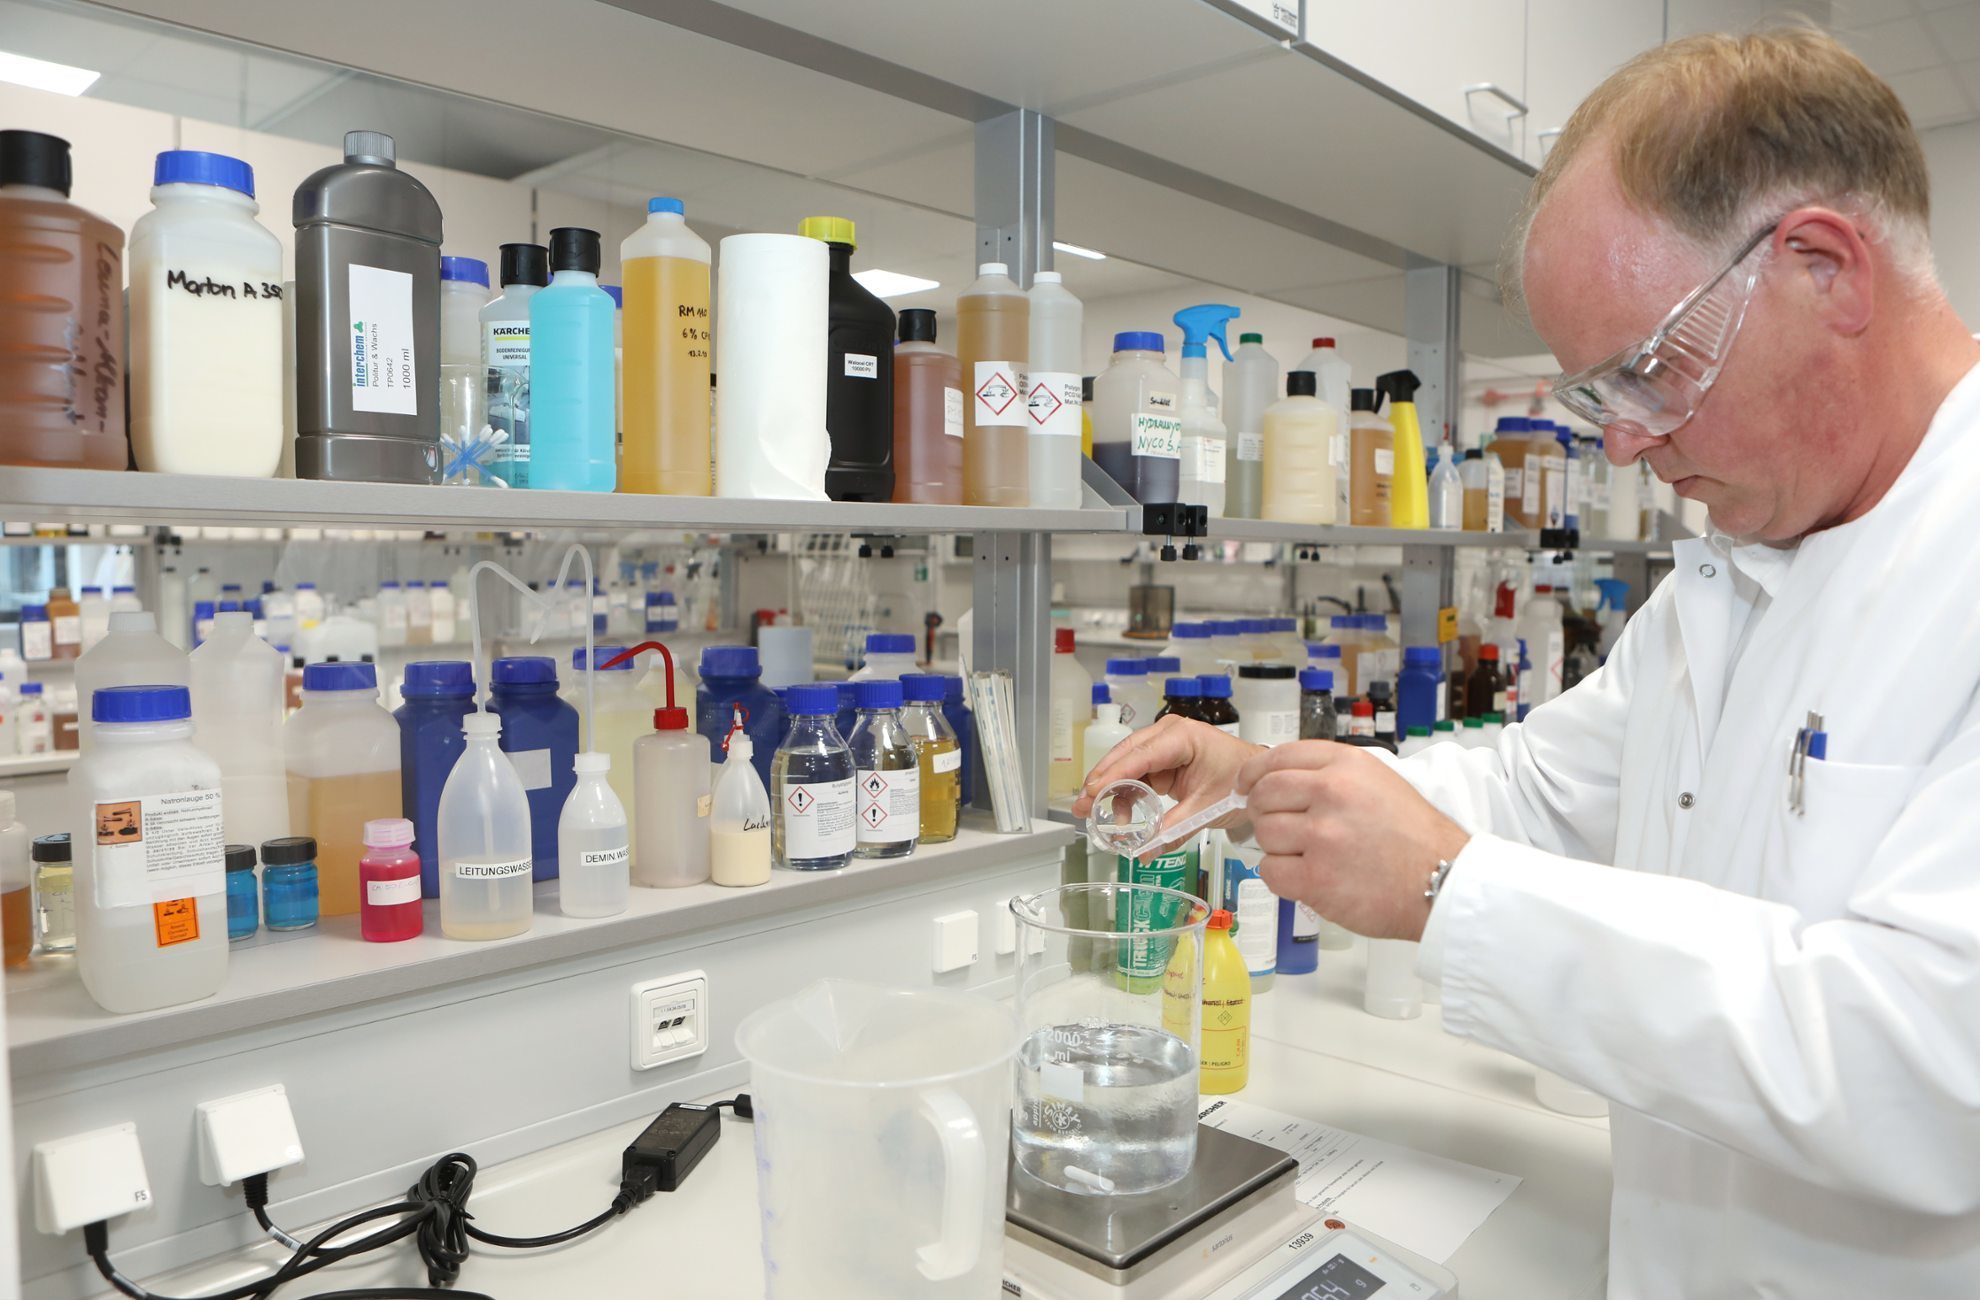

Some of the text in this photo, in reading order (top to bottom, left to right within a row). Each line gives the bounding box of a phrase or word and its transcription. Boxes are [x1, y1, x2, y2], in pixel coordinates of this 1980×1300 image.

[678, 304, 695, 318] RM
[370, 323, 379, 351] Wachs
[352, 335, 366, 388] interchem
[400, 348, 412, 389] 1000 ml
[372, 362, 380, 388] Politur
[1137, 436, 1165, 453] NYCO
[160, 795, 204, 806] Natronlauge
[205, 793, 214, 801] 50
[459, 860, 533, 877] LEITUNGSWASSE
[1046, 1030, 1081, 1047] 2000
[1054, 1050, 1071, 1062] ml
[1043, 1101, 1081, 1123] SIMAX
[1288, 1231, 1315, 1251] 13939
